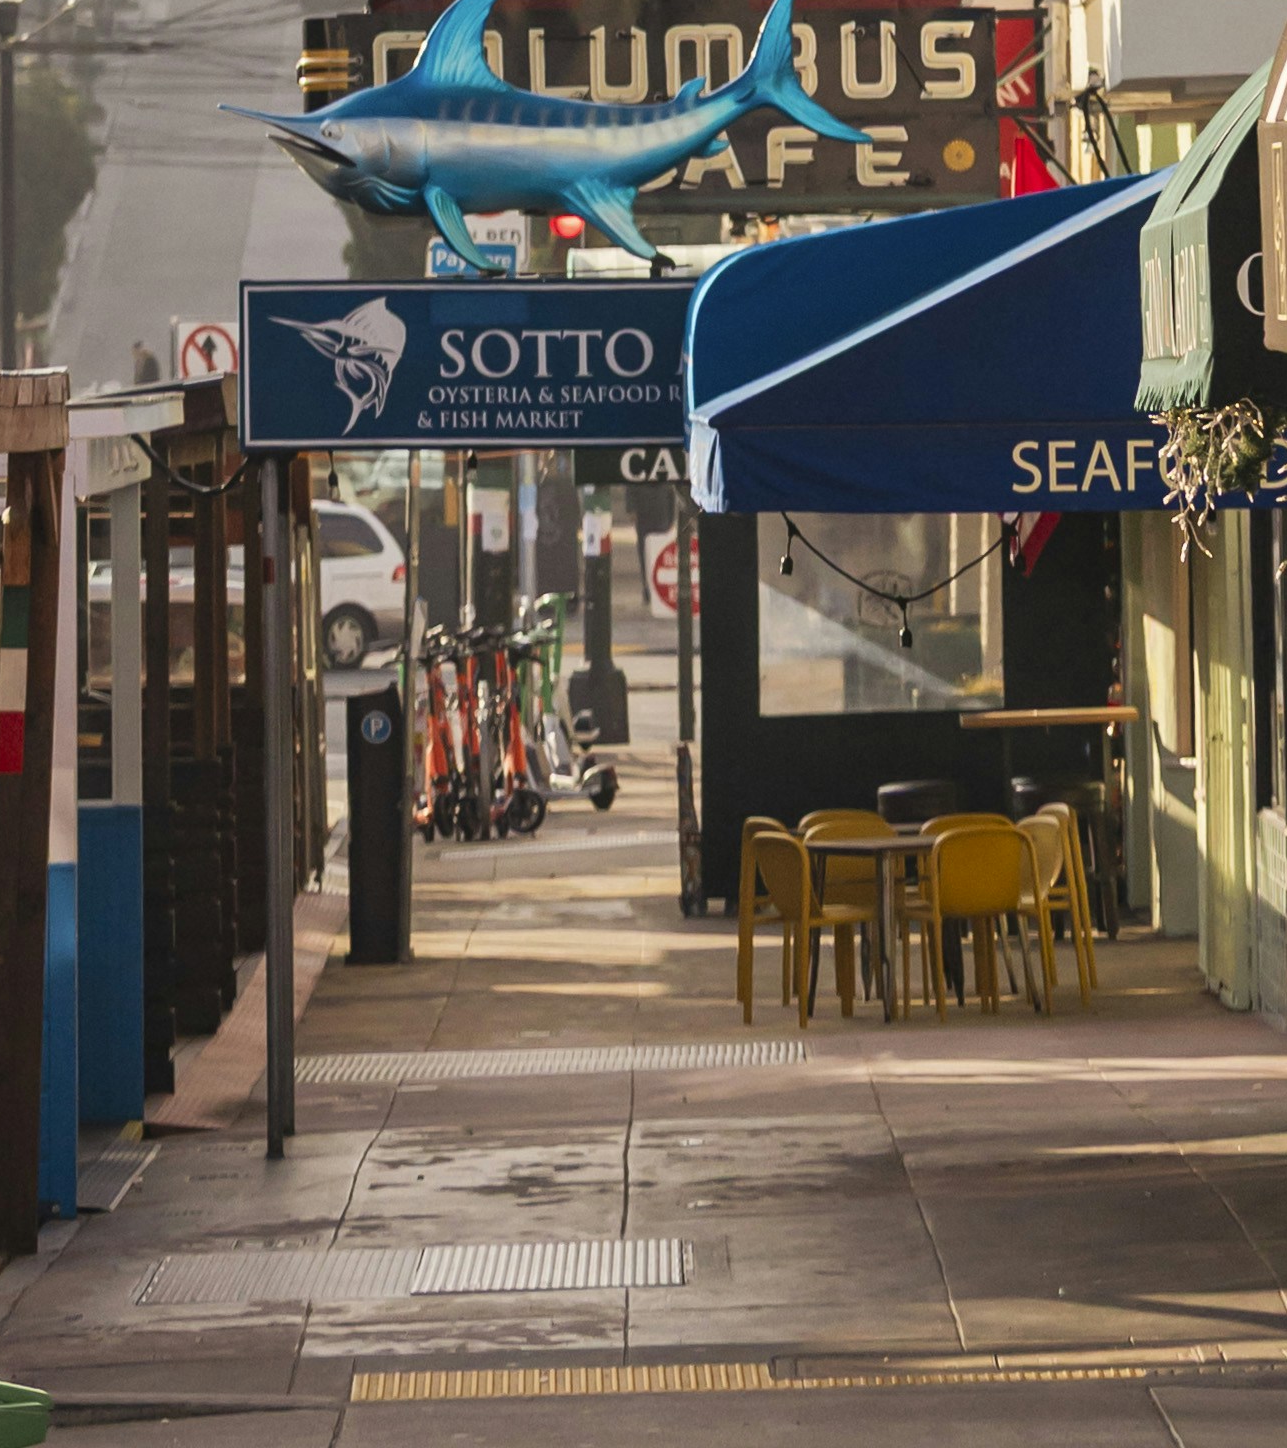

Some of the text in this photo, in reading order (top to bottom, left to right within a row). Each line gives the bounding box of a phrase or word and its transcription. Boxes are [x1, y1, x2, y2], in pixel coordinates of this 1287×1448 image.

[637, 123, 912, 191] AFE
[439, 328, 654, 380] SOTTO
[428, 385, 530, 407] OYSTERIA
[539, 386, 555, 405] &
[560, 385, 661, 405] SEAFOOD
[417, 409, 584, 430] & FISH MARKET
[620, 447, 691, 483] CA
